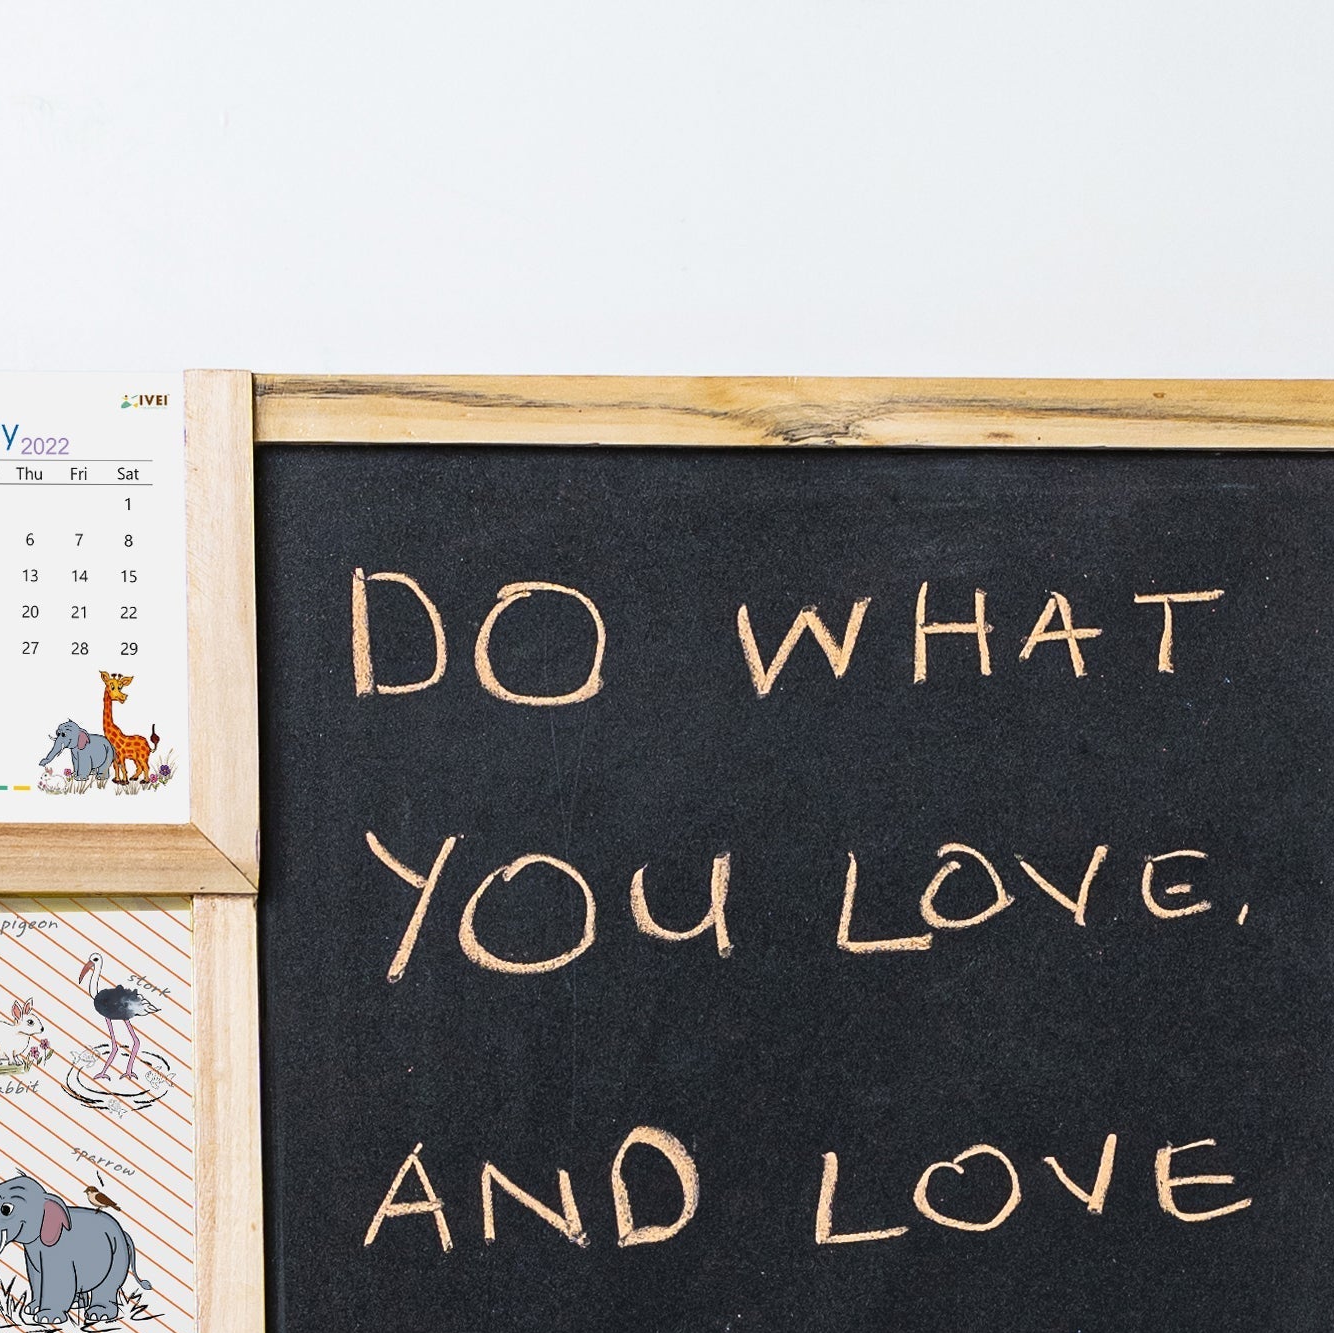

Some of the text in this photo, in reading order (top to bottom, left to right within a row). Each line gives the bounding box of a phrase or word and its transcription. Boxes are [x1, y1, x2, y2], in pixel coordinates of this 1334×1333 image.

[139, 394, 168, 406] IVEI
[22, 438, 69, 455] 2022
[16, 467, 42, 480] Thu
[71, 468, 87, 480] Fri
[118, 467, 139, 480] Sat
[124, 498, 131, 510] 1
[25, 533, 35, 546] 6
[74, 534, 84, 546] 7
[123, 535, 134, 547] 8
[22, 569, 39, 582] 13
[71, 570, 89, 582] 14
[120, 570, 138, 583] 15
[21, 605, 40, 618] 20
[70, 606, 87, 619] 21
[120, 607, 138, 619] 22
[352, 568, 1223, 705] DO WHAT
[21, 642, 40, 654] 27
[71, 642, 89, 655] 28
[120, 642, 139, 655] 29
[366, 833, 1248, 978] YOU LOVE,
[0, 917, 59, 937] pigeon
[127, 973, 171, 997] stork
[70, 1144, 136, 1177] sparrow
[365, 1126, 1251, 1251] AND LOVE
